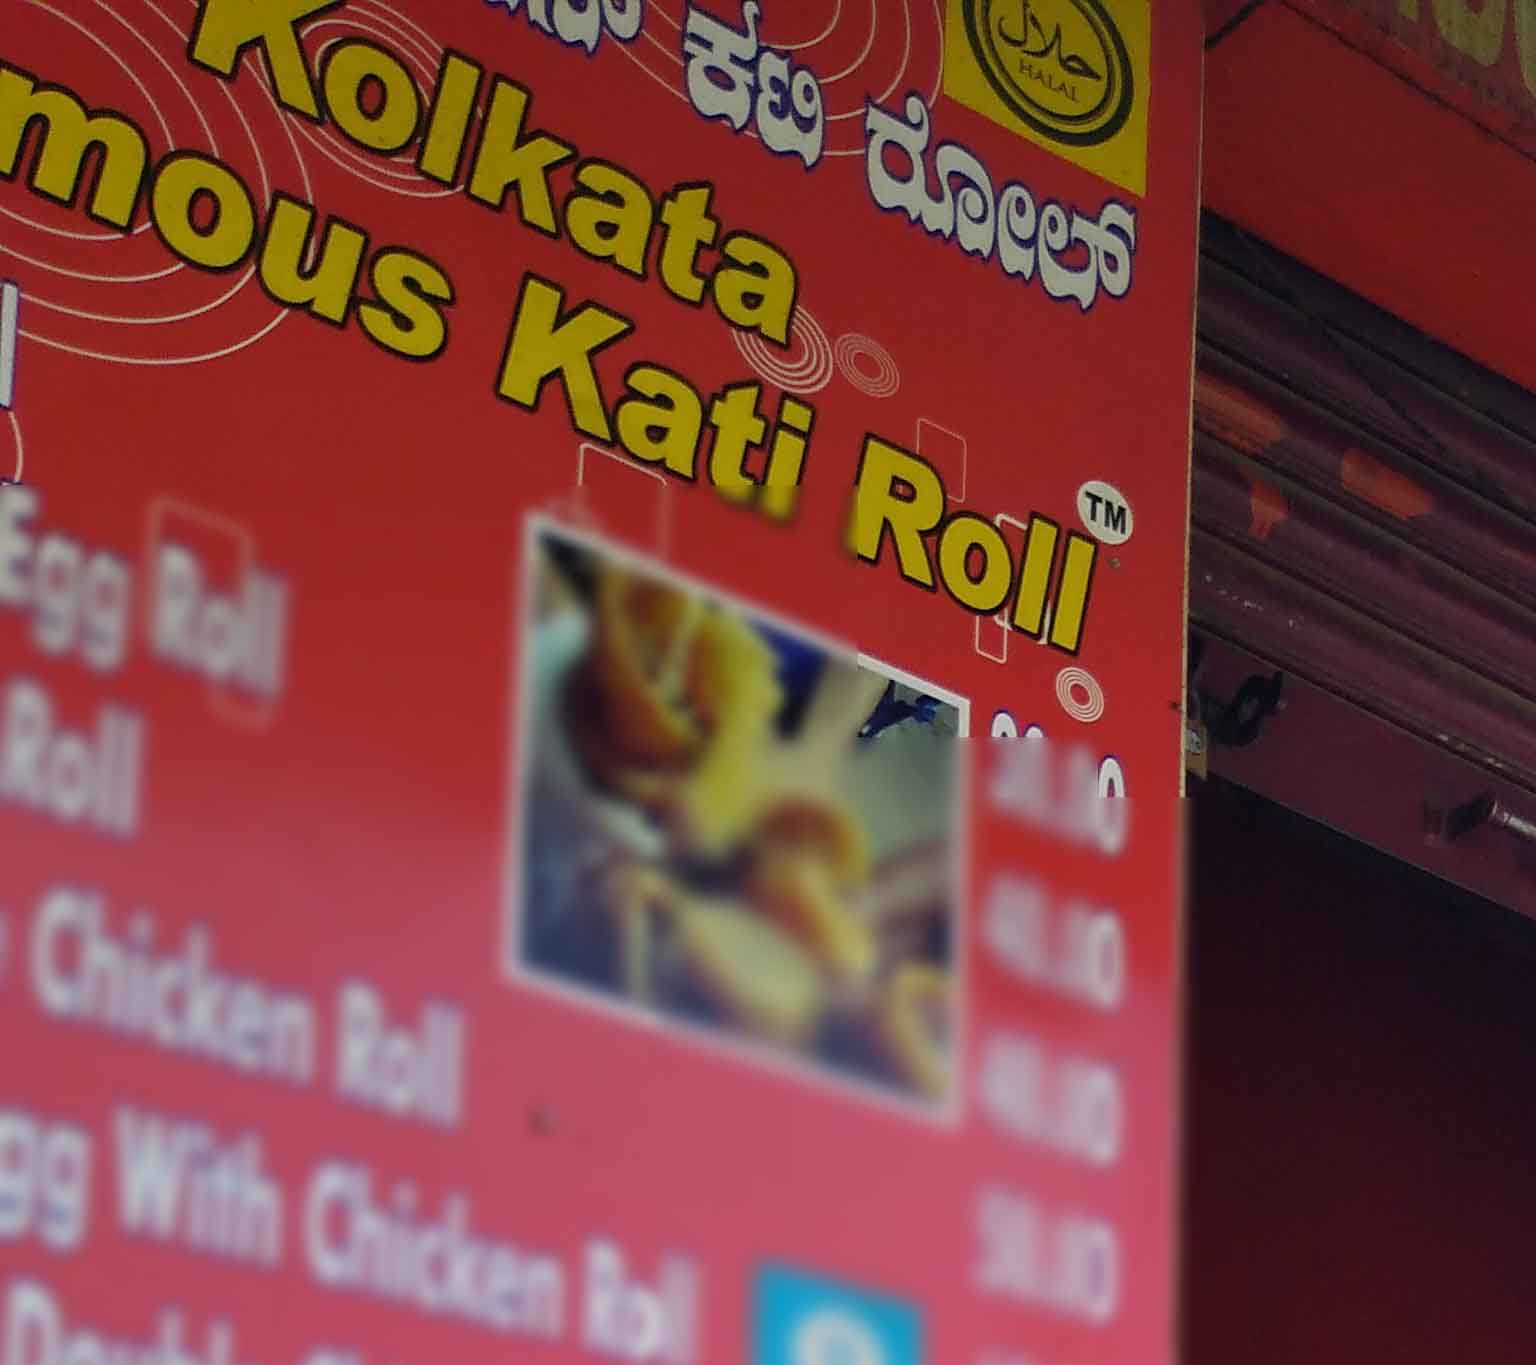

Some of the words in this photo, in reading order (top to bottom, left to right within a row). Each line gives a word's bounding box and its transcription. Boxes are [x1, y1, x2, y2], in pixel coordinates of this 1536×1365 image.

[189, 0, 799, 348] Kolkata
[1019, 60, 1079, 103] HALAL
[497, 272, 816, 530] Kati
[845, 433, 1099, 655] Roll
[1085, 491, 1128, 537] TM
